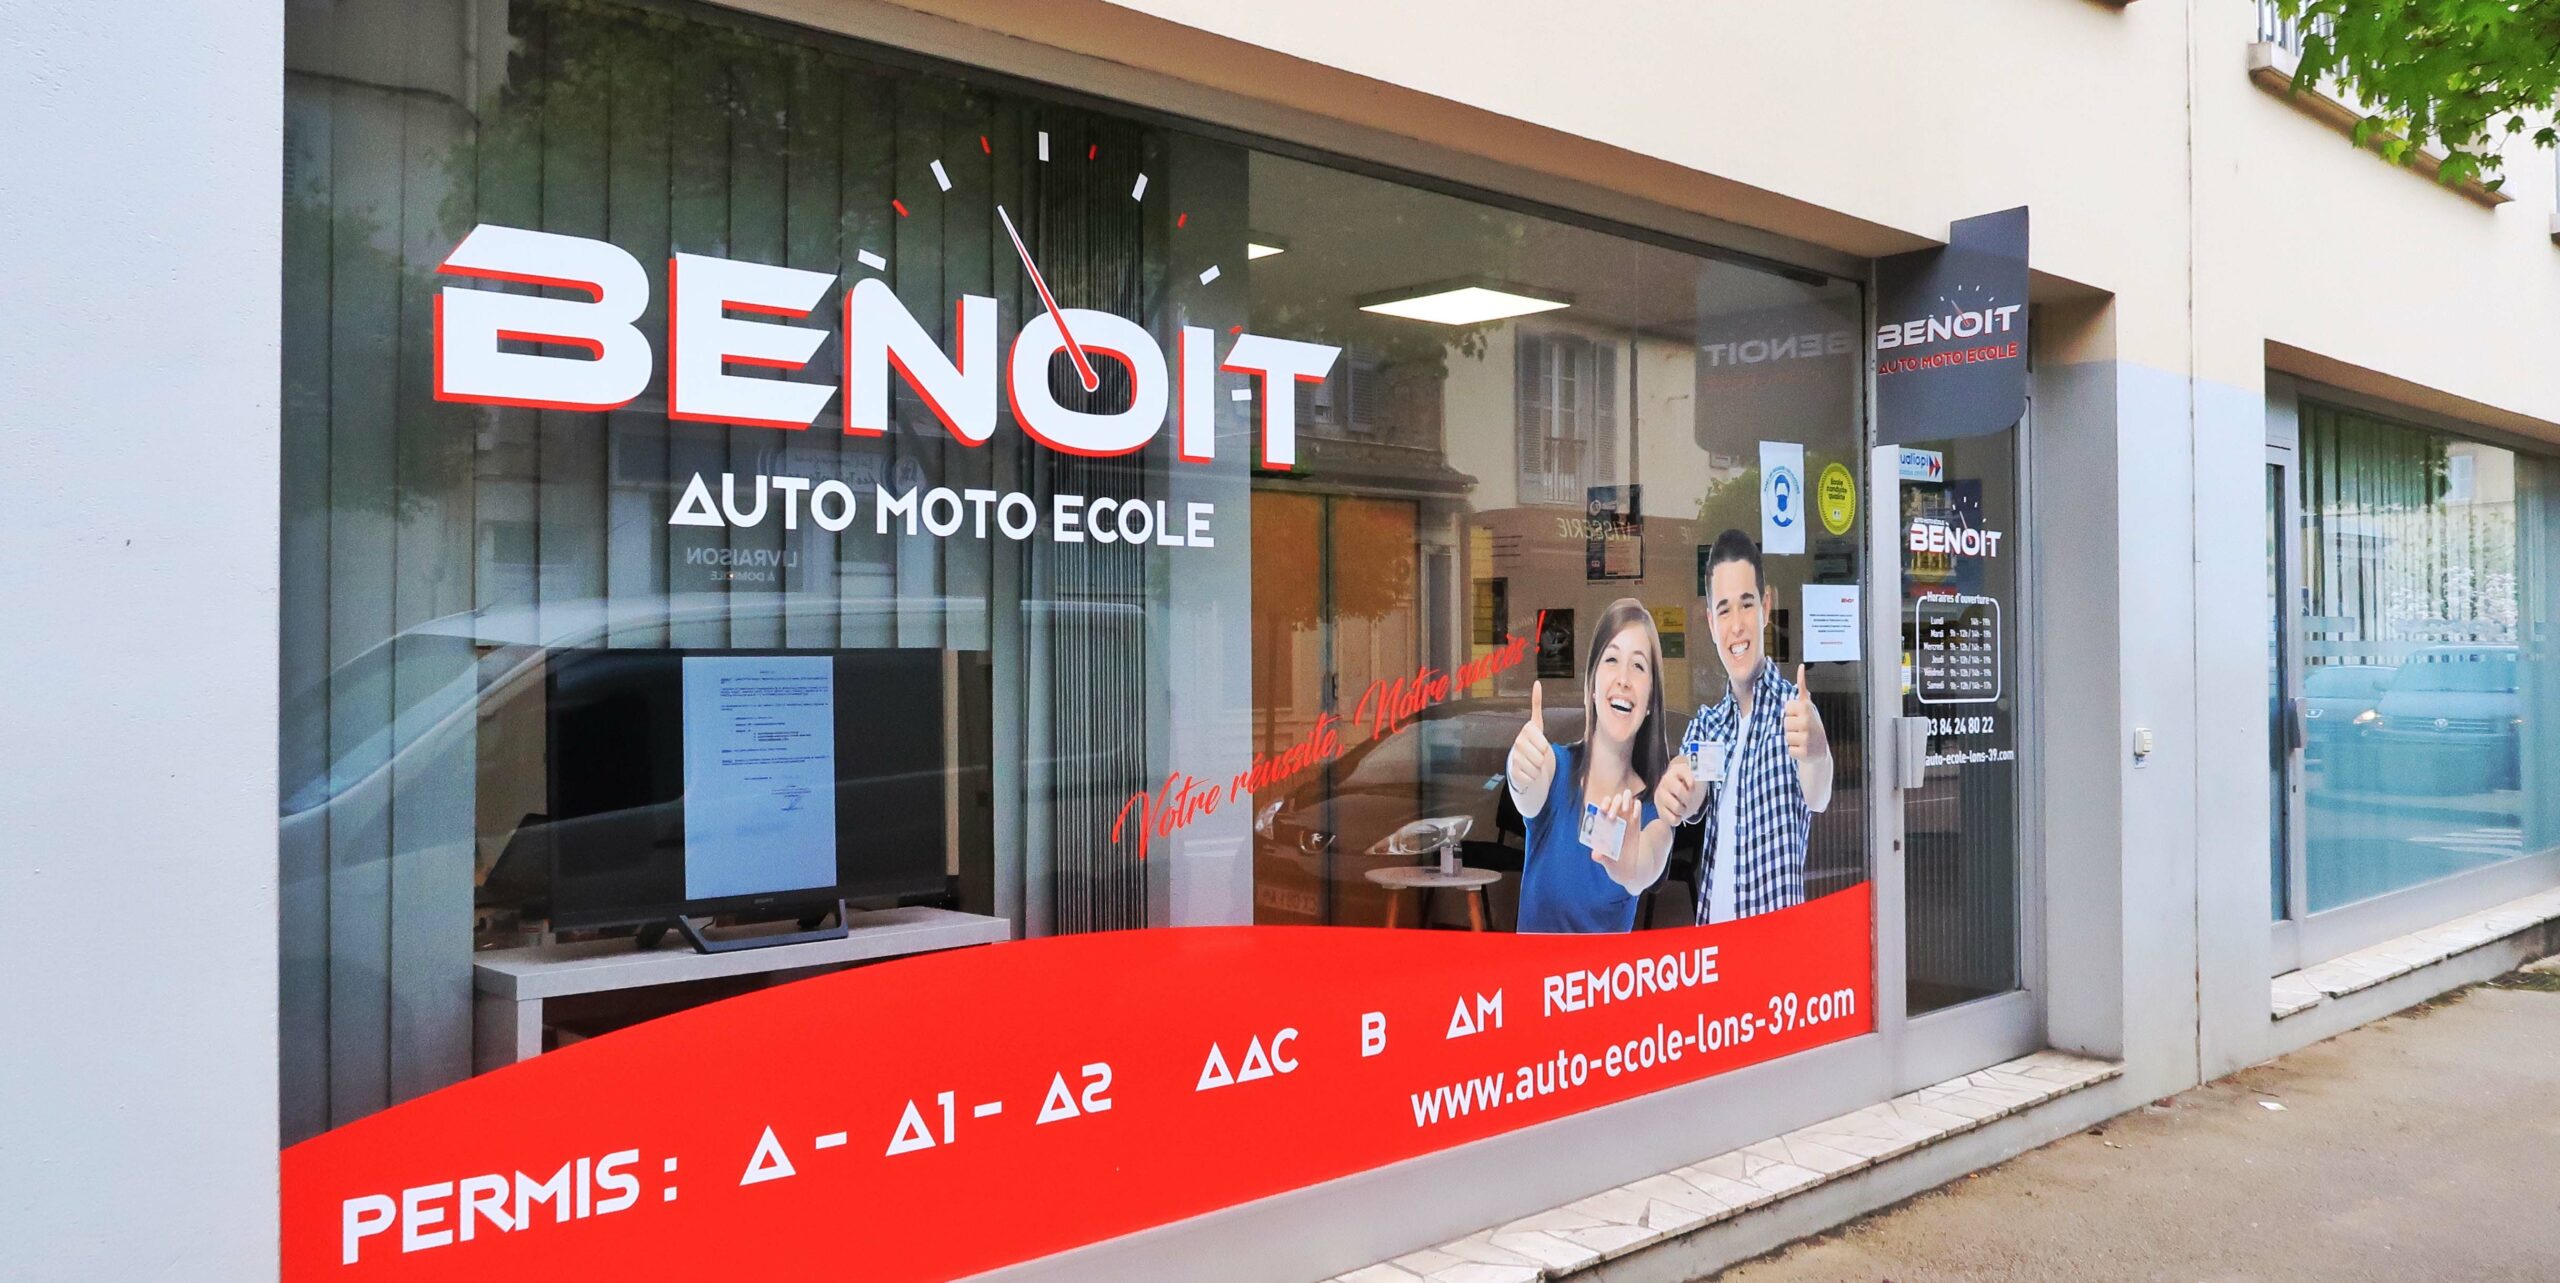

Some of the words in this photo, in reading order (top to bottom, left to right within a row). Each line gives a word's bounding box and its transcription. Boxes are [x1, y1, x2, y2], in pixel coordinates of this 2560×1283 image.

[433, 223, 1342, 470] BENOIT
[1877, 304, 2022, 350] BENOIT
[1878, 357, 1918, 376] AUTO
[1921, 350, 1964, 370] MOTO
[1966, 341, 2020, 364] ECOLE
[1900, 453, 1929, 468] ualiopi
[669, 472, 856, 532] AUTO
[876, 483, 1037, 540] MOTO
[1053, 494, 1215, 548] ECOLE
[1910, 522, 2003, 558] BENOIT
[1112, 771, 1220, 860] Votre
[1354, 665, 1450, 741] Notre
[1455, 633, 1529, 692] succès
[1939, 718, 1952, 735] 84
[1954, 717, 1966, 735] 24
[1968, 716, 1980, 734] 80
[1981, 716, 1994, 733] 22
[1411, 984, 1856, 1128] www.auto-ecole-lons-39.com
[343, 1149, 640, 1265] PERMIS
[740, 1125, 797, 1186] A
[1036, 1062, 1113, 1125] A2
[1196, 1027, 1299, 1091] AAC
[1362, 1011, 1387, 1058] B
[1446, 988, 1503, 1040] AM
[1544, 946, 1720, 1017] REMORQUE
